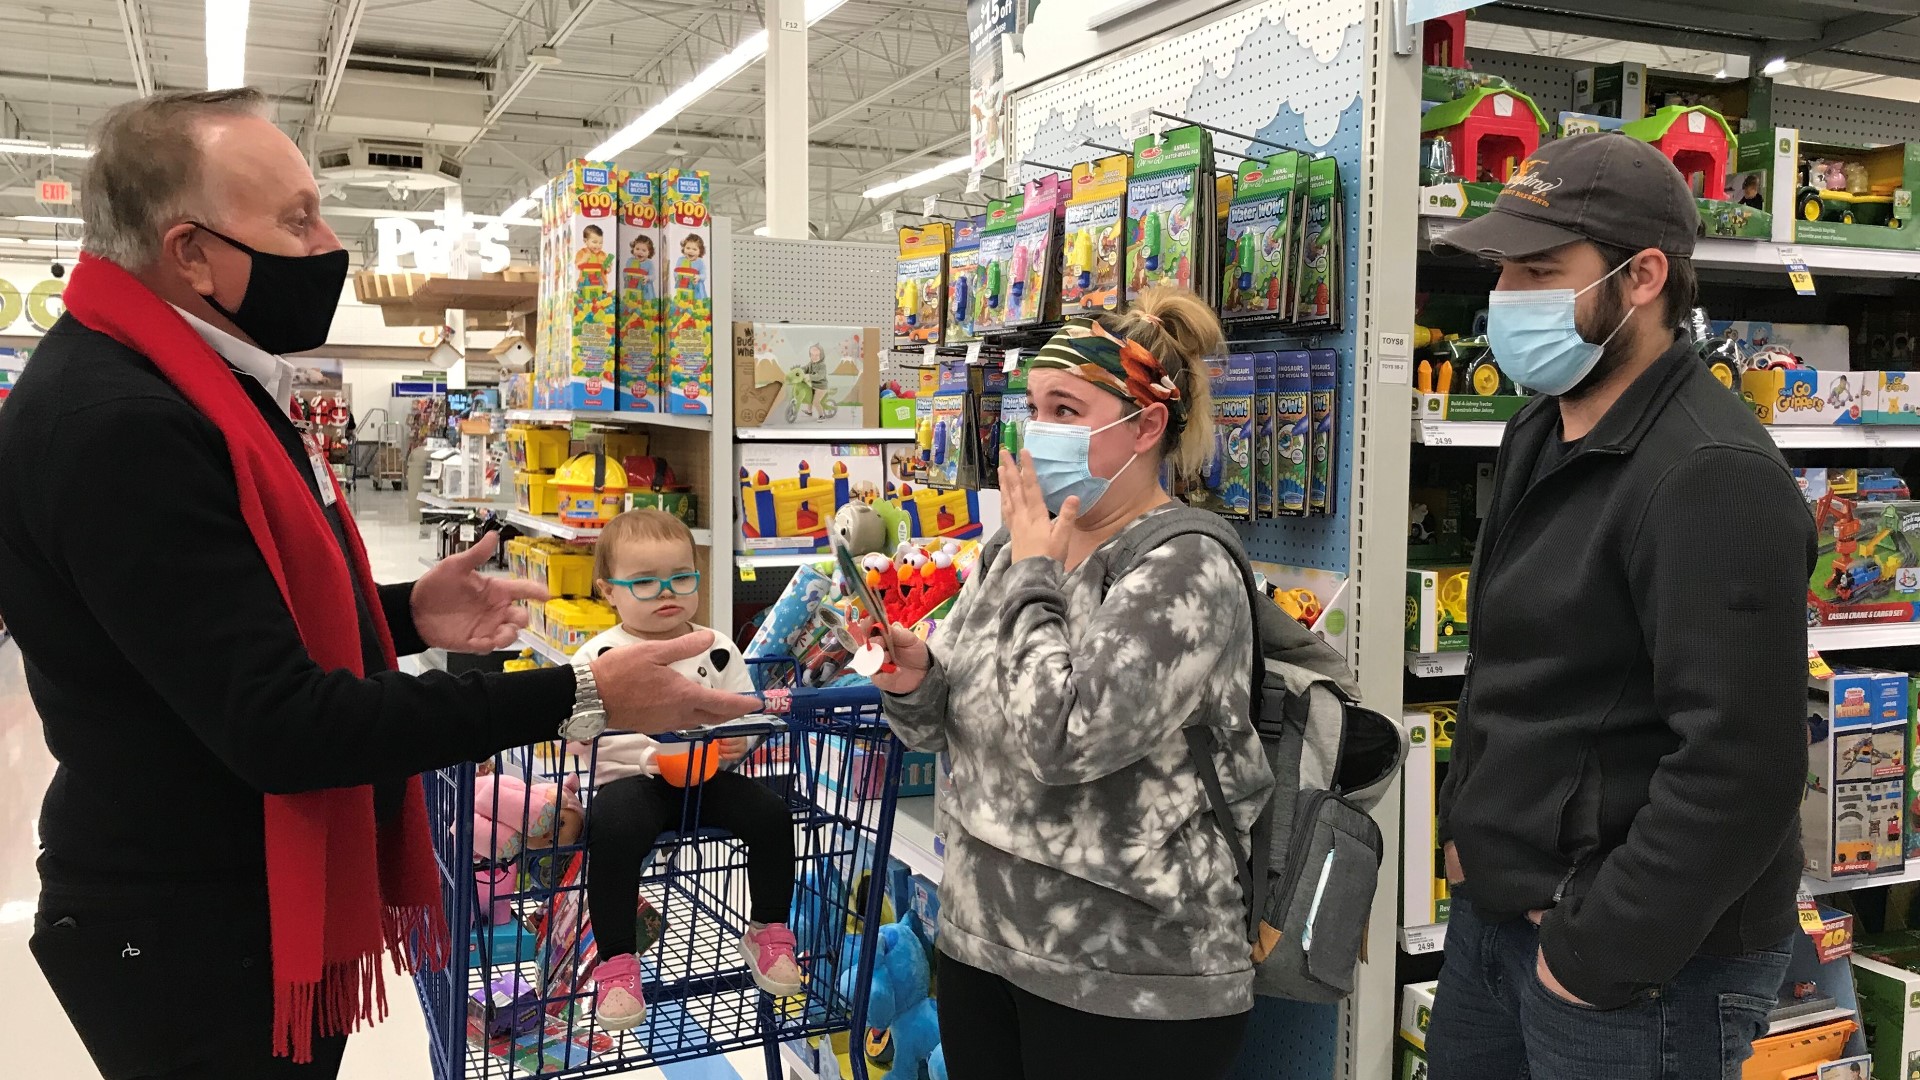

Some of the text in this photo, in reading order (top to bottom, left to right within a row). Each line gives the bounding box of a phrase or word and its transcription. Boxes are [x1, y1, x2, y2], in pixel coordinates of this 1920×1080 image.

[42, 183, 65, 200] EXIT
[1131, 183, 1160, 202] Water
[1161, 174, 1191, 197] WOW!
[579, 194, 611, 208] 100
[674, 202, 705, 217] 100
[624, 202, 656, 218] 100
[1068, 207, 1092, 224] Water
[1093, 199, 1118, 220] WOW!
[1231, 207, 1257, 223] Water
[1258, 198, 1285, 218] WOW!
[1308, 205, 1326, 223] OW!
[374, 218, 510, 274] Pets
[982, 234, 1014, 252] Water WO
[900, 258, 939, 275] Water WOW!
[1793, 381, 1810, 396] Go
[1222, 400, 1247, 418] WOW!
[1257, 397, 1268, 415] W!
[1279, 397, 1303, 414] OW!
[1314, 395, 1326, 412] W!
[1776, 396, 1824, 412] Grippers
[832, 444, 880, 456] INTEX
[1426, 666, 1443, 674] 14.99
[1418, 942, 1435, 950] 24.99
[1821, 928, 1850, 948] 40+
